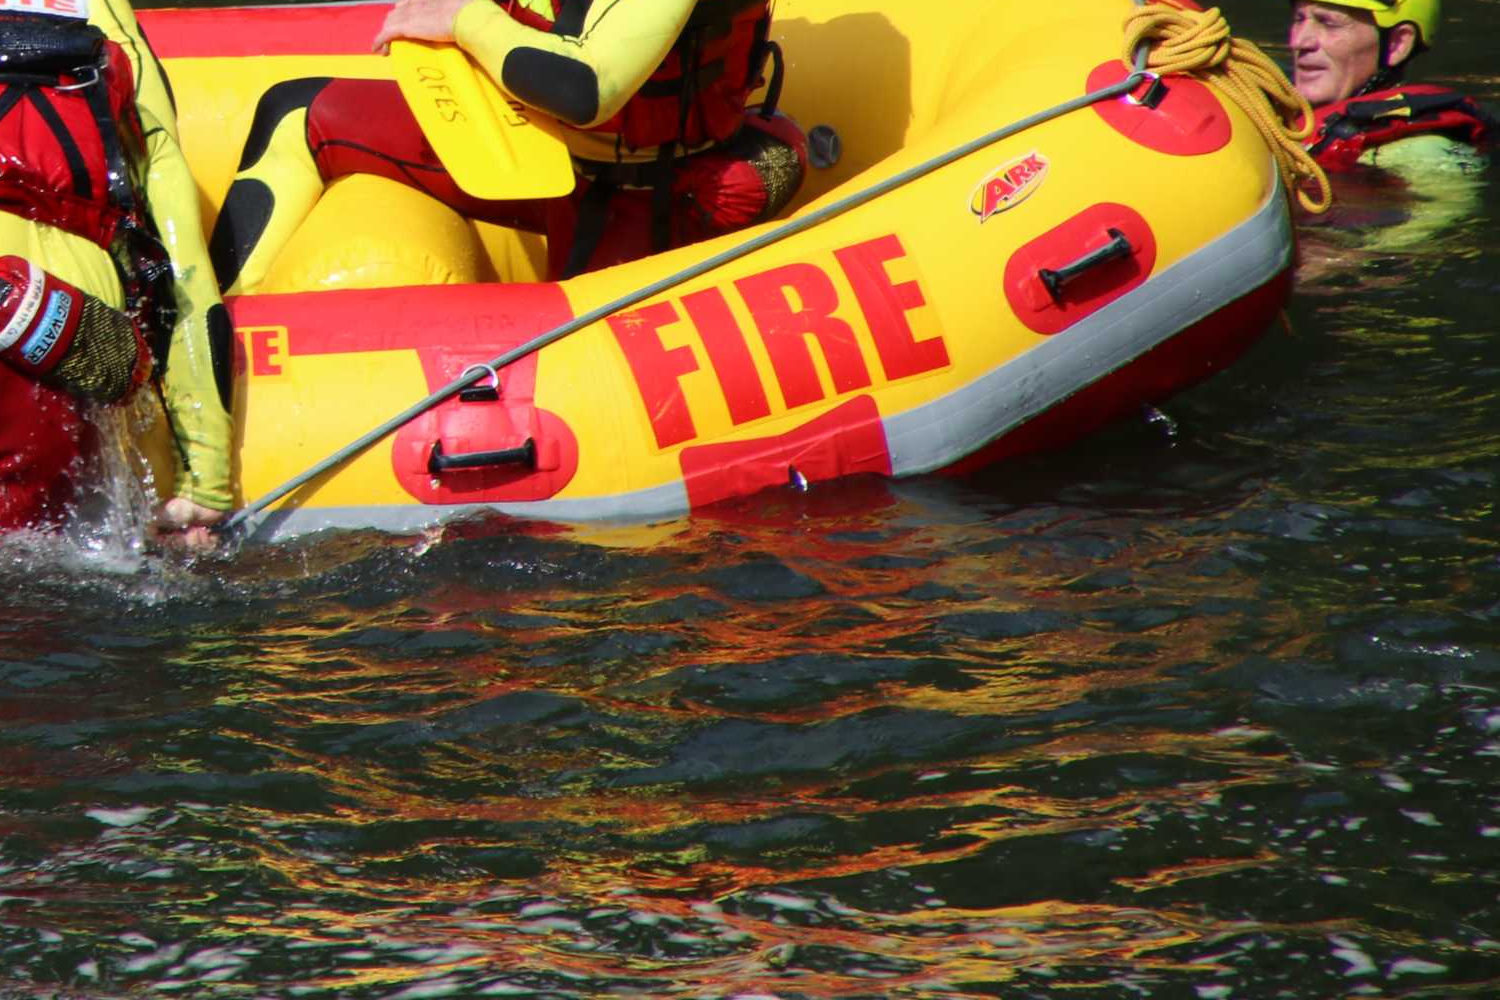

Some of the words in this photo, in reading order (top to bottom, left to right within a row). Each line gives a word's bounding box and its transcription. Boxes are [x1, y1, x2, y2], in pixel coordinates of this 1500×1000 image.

[981, 152, 1046, 219] ARK
[27, 317, 65, 363] WATER
[605, 233, 951, 450] FIRE
